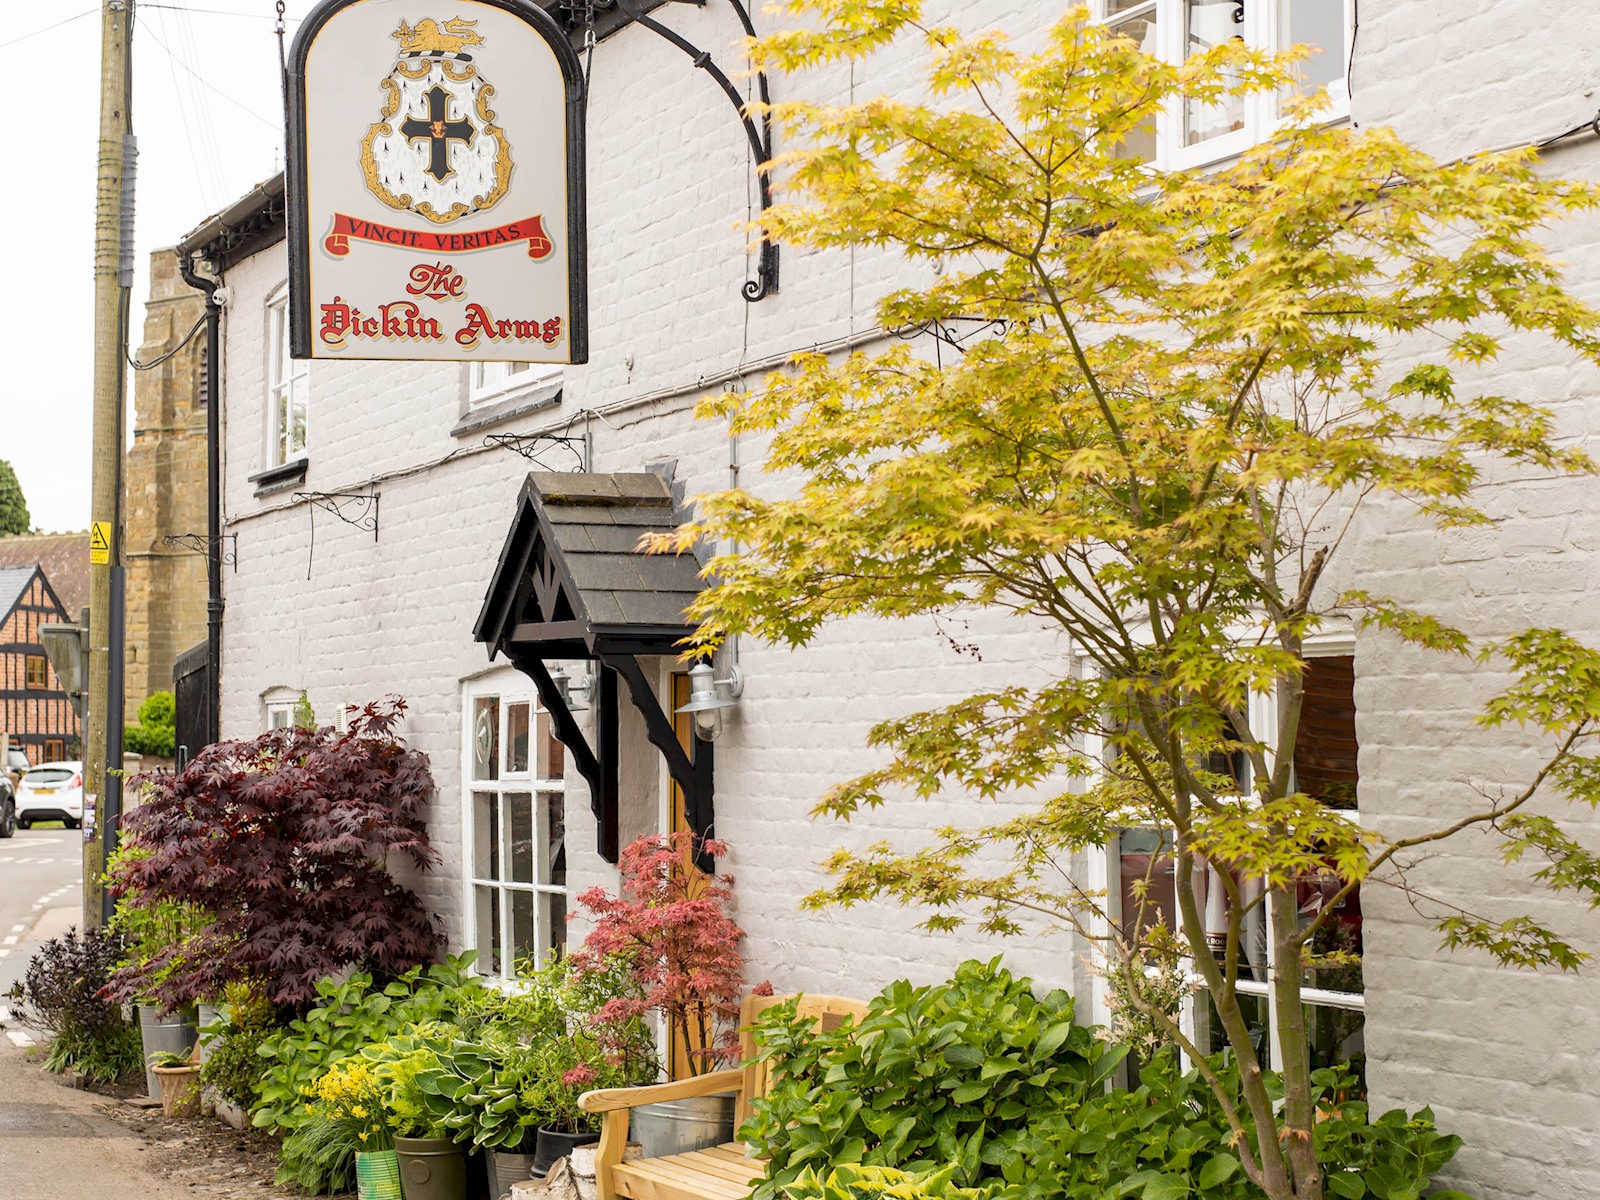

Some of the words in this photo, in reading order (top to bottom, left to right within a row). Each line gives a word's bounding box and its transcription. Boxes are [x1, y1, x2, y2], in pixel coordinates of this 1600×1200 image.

[406, 261, 464, 300] The
[320, 296, 443, 345] Dickin
[455, 303, 562, 346] Arms
